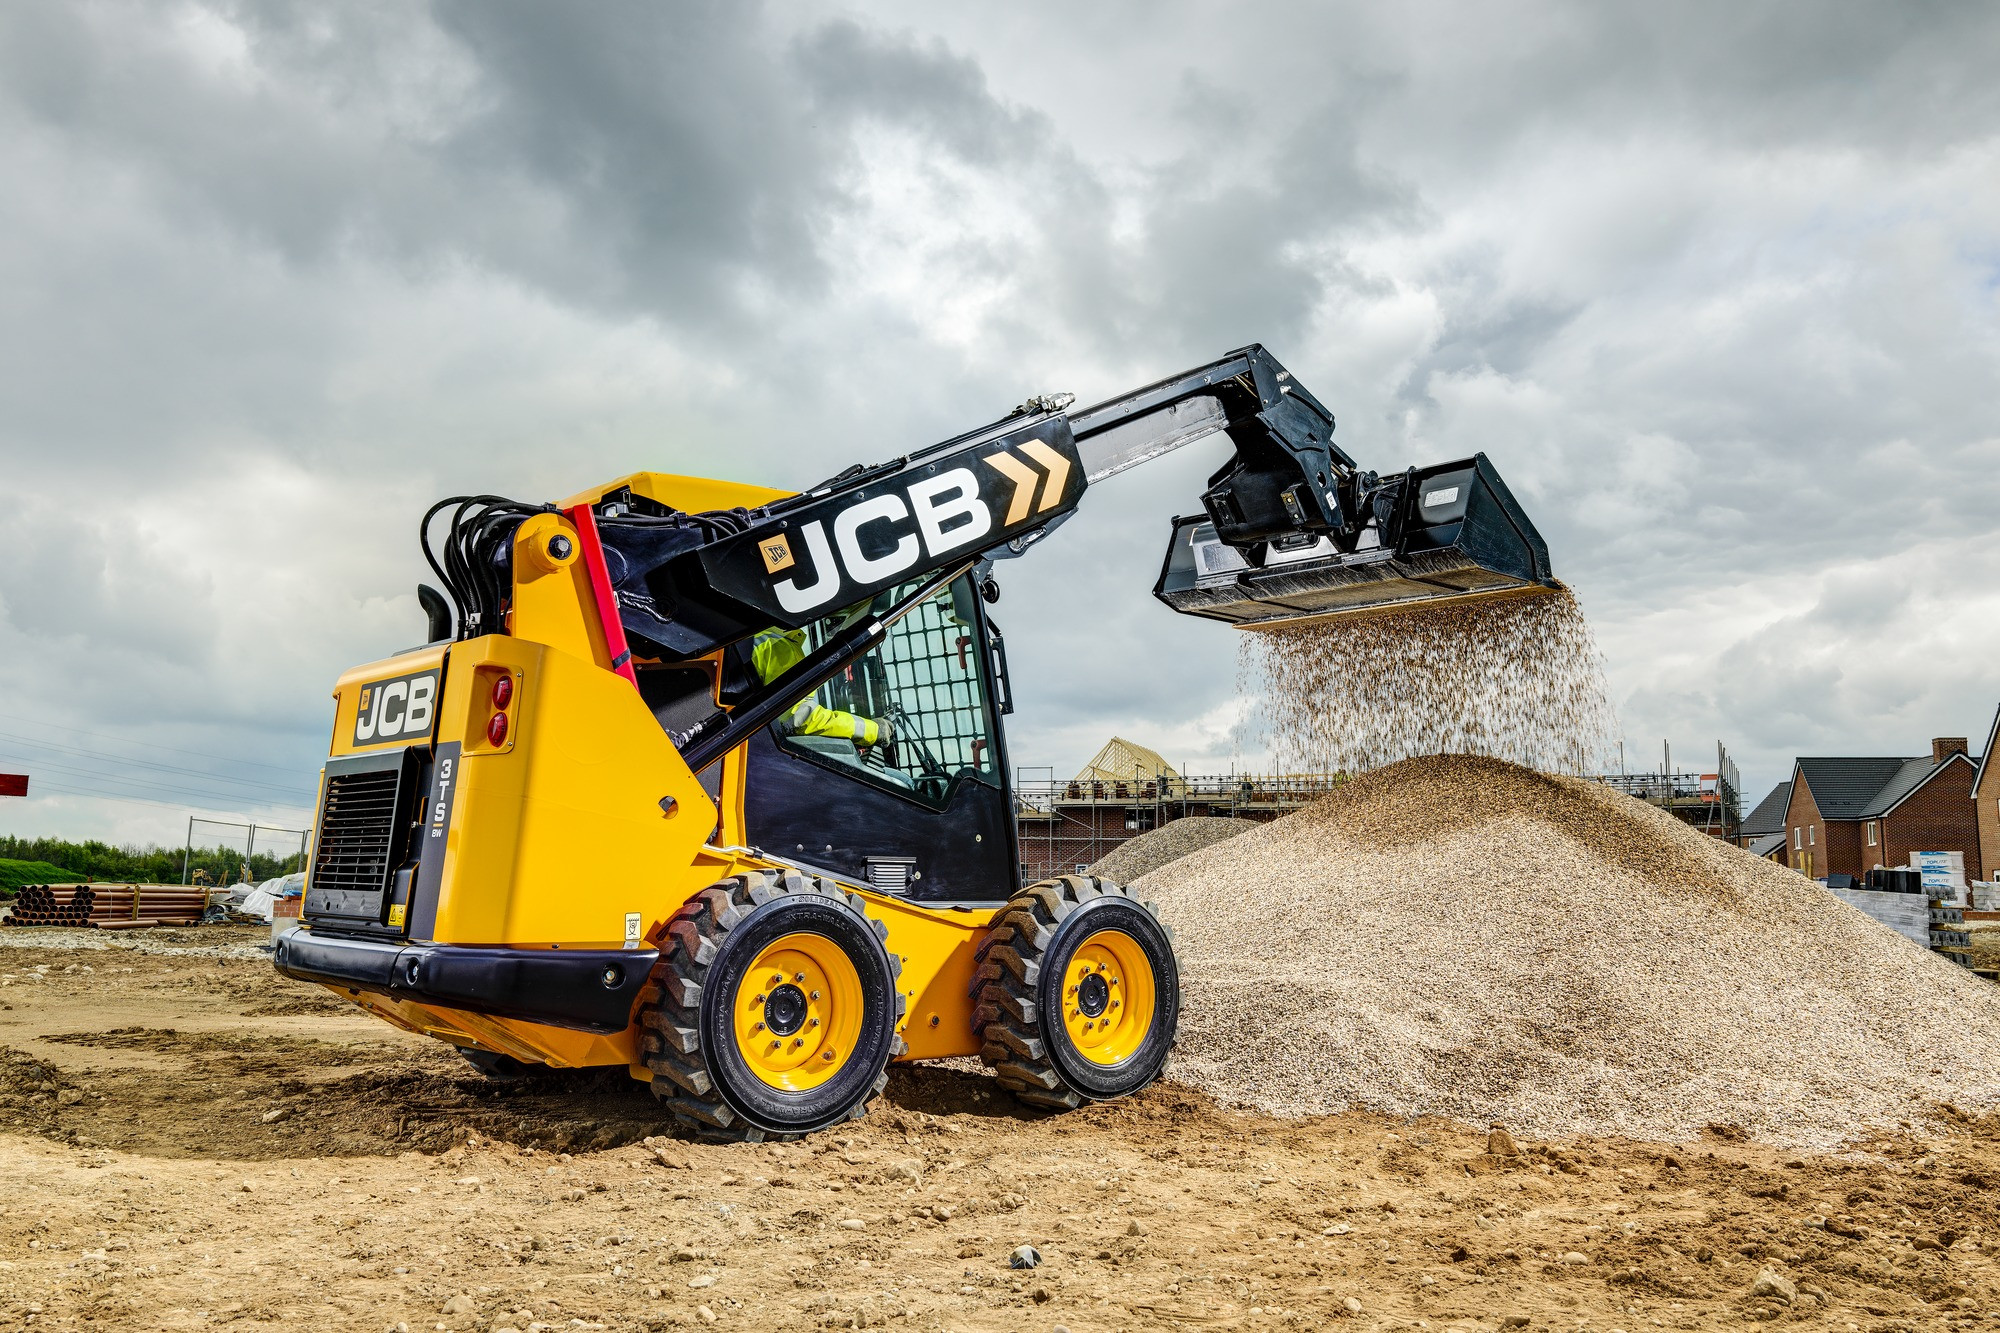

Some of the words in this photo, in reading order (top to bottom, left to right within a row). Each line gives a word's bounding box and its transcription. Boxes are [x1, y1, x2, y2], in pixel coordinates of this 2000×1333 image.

[768, 545, 786, 562] JCB
[773, 468, 991, 613] JCB
[357, 676, 435, 740] JCB
[798, 895, 840, 910] SOLIDEAL
